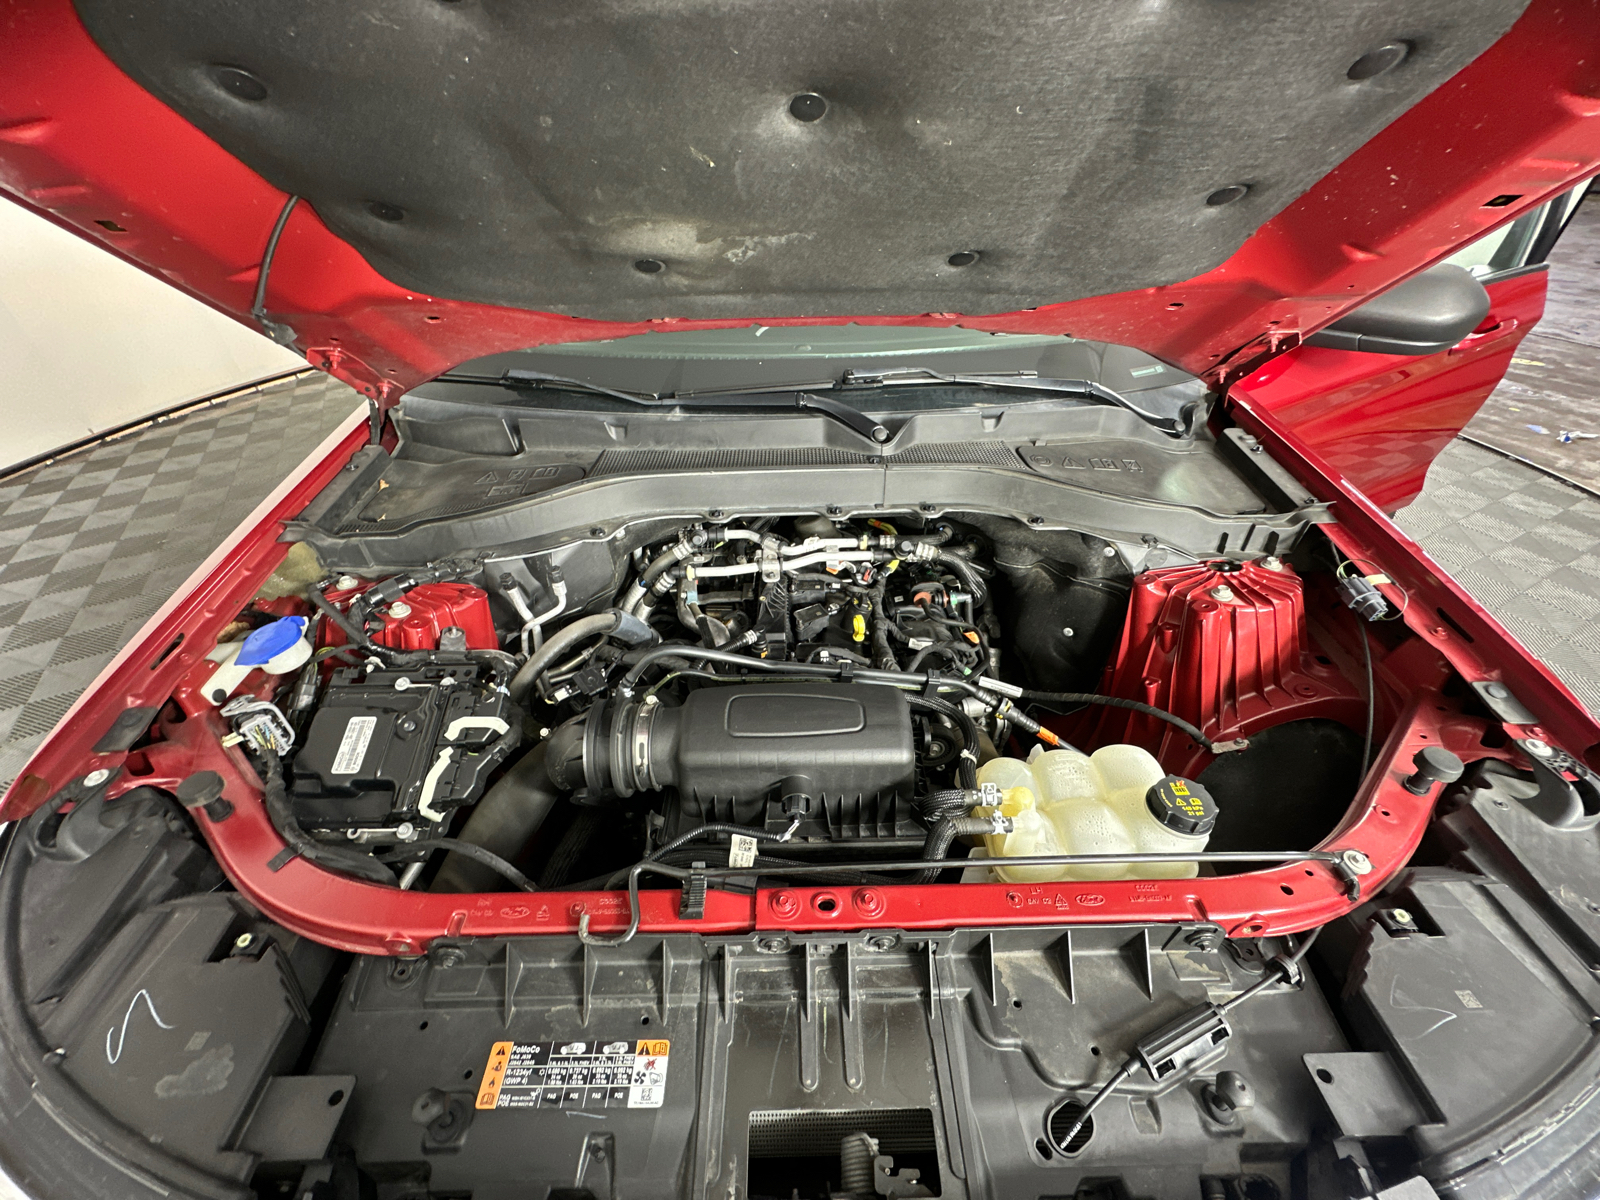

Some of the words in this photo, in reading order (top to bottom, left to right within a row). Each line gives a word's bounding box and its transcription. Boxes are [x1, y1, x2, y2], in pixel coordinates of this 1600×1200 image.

[511, 1045, 540, 1053] FoMoCo
[506, 1068, 532, 1076] R-1234yf
[504, 1077, 521, 1085] (GWP
